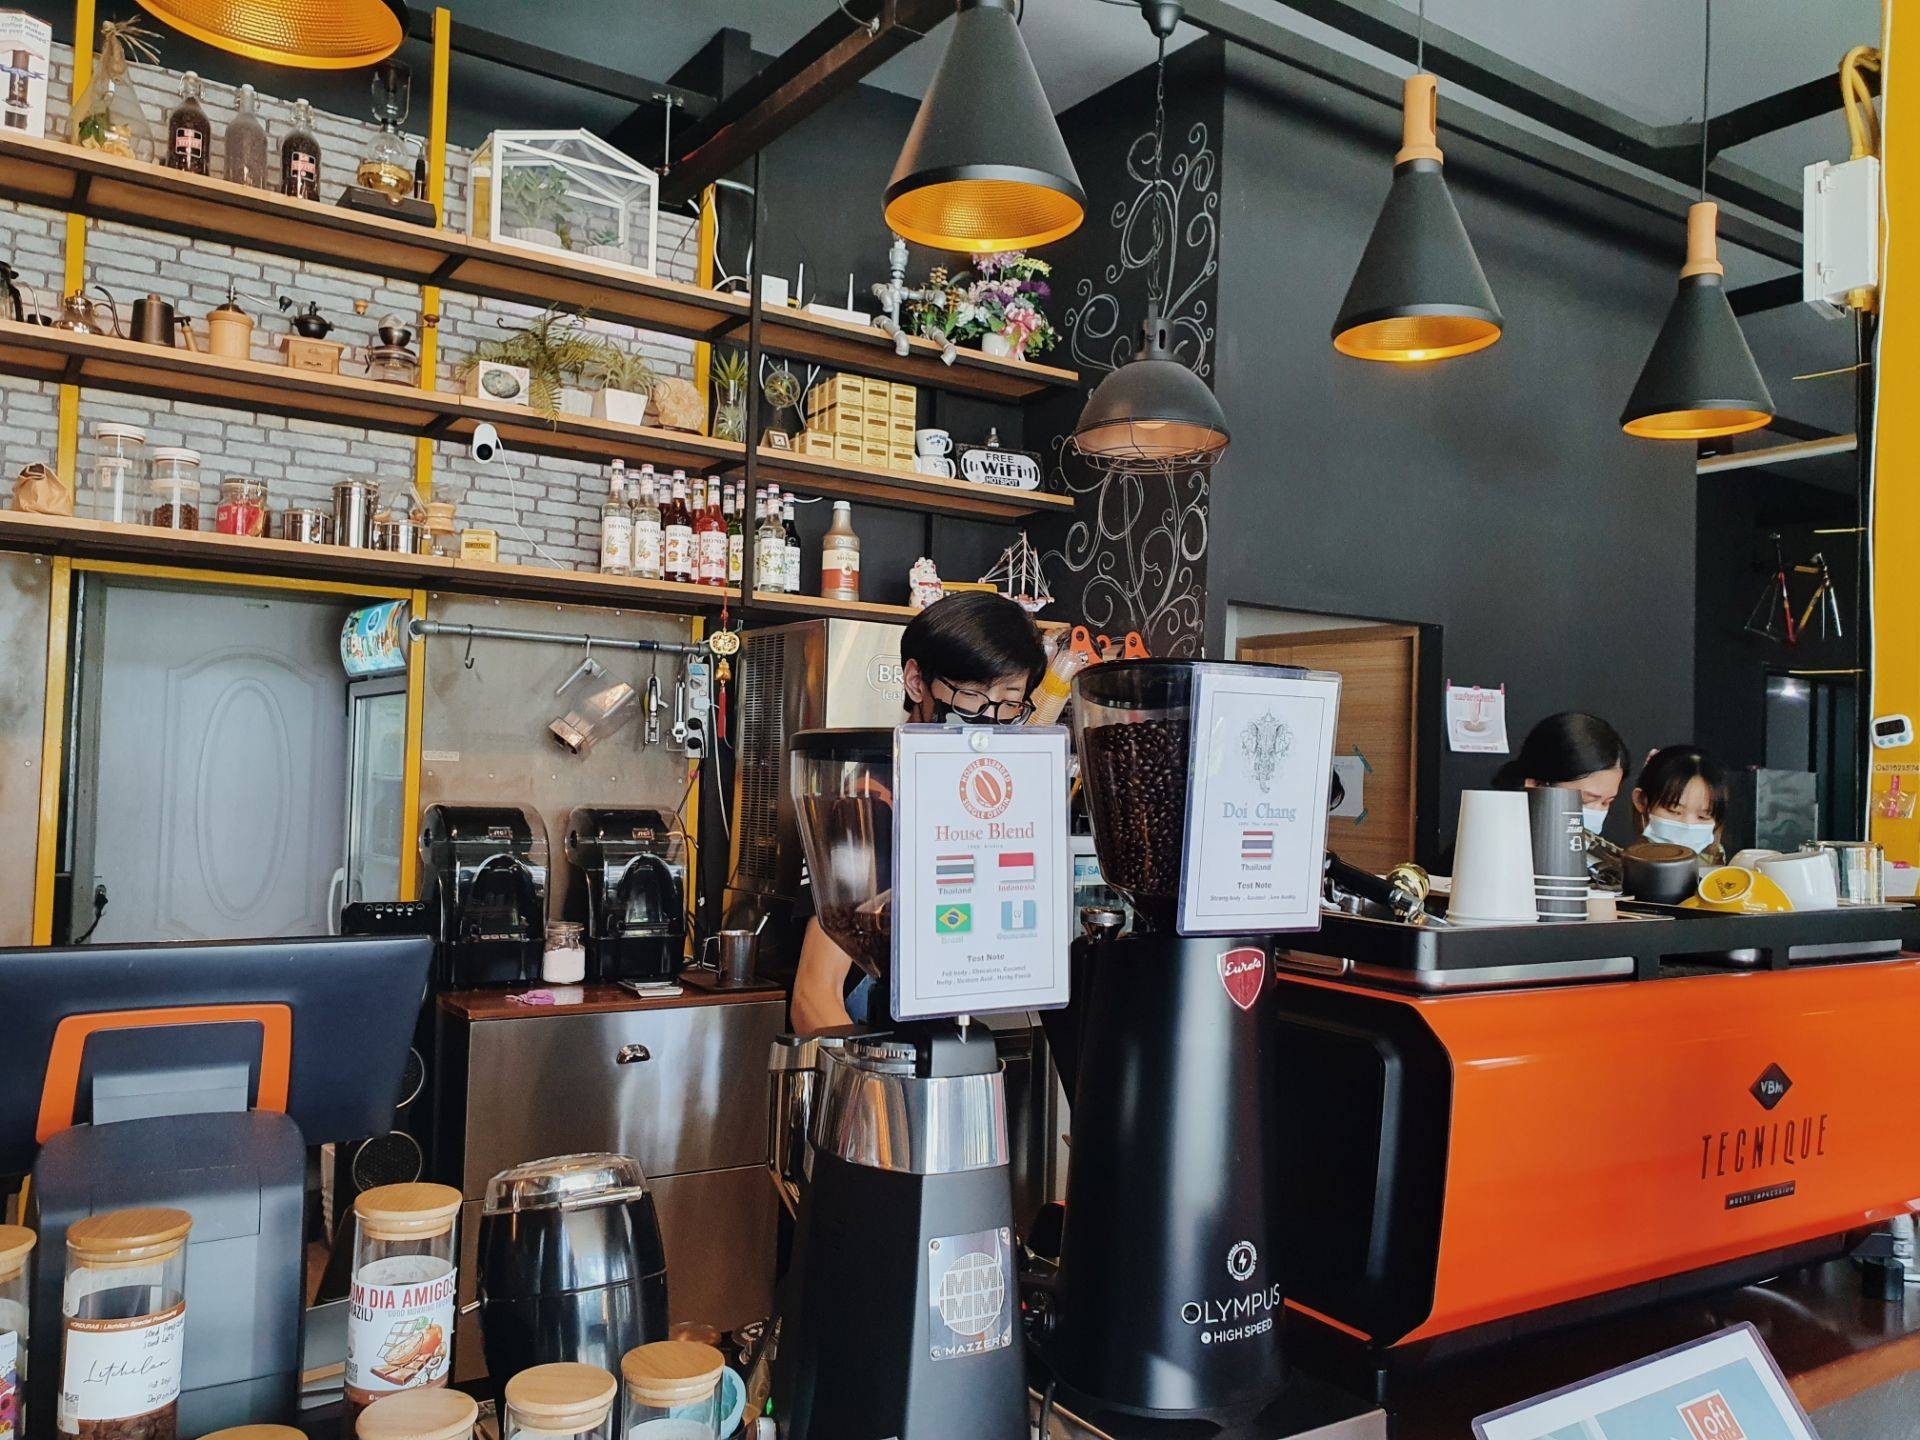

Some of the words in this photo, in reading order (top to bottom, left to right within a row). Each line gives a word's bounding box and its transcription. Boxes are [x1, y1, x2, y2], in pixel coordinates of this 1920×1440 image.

[986, 452, 1014, 463] FREE
[981, 461, 1022, 478] WiFi
[985, 476, 1020, 487] HOTSPOT
[879, 664, 904, 683] BR
[960, 758, 982, 782] HOUSE
[962, 798, 985, 819] SINGLE
[986, 797, 1012, 819] ORIGIN
[1222, 802, 1248, 818] Doi
[1255, 802, 1297, 822] Chang
[935, 825, 983, 841] House
[988, 822, 1034, 840] Blend
[1087, 865, 1100, 875] SA
[1241, 863, 1272, 871] Thailand
[938, 887, 972, 896] Thailand
[998, 883, 1036, 892] Indonesia
[1237, 881, 1253, 889] Test
[1255, 881, 1272, 889] Note
[967, 954, 984, 962] Test
[987, 953, 1005, 961] Note
[1760, 1080, 1784, 1095] VBM
[1701, 1114, 1828, 1180] TECNIQUE
[1729, 1194, 1751, 1206] MULTI
[369, 1288, 396, 1309] DIA
[1181, 1283, 1280, 1325] OLYMPUS
[1213, 1326, 1243, 1344] HIGH
[1244, 1318, 1273, 1338] SPEED
[944, 1335, 1001, 1357] MAZZER
